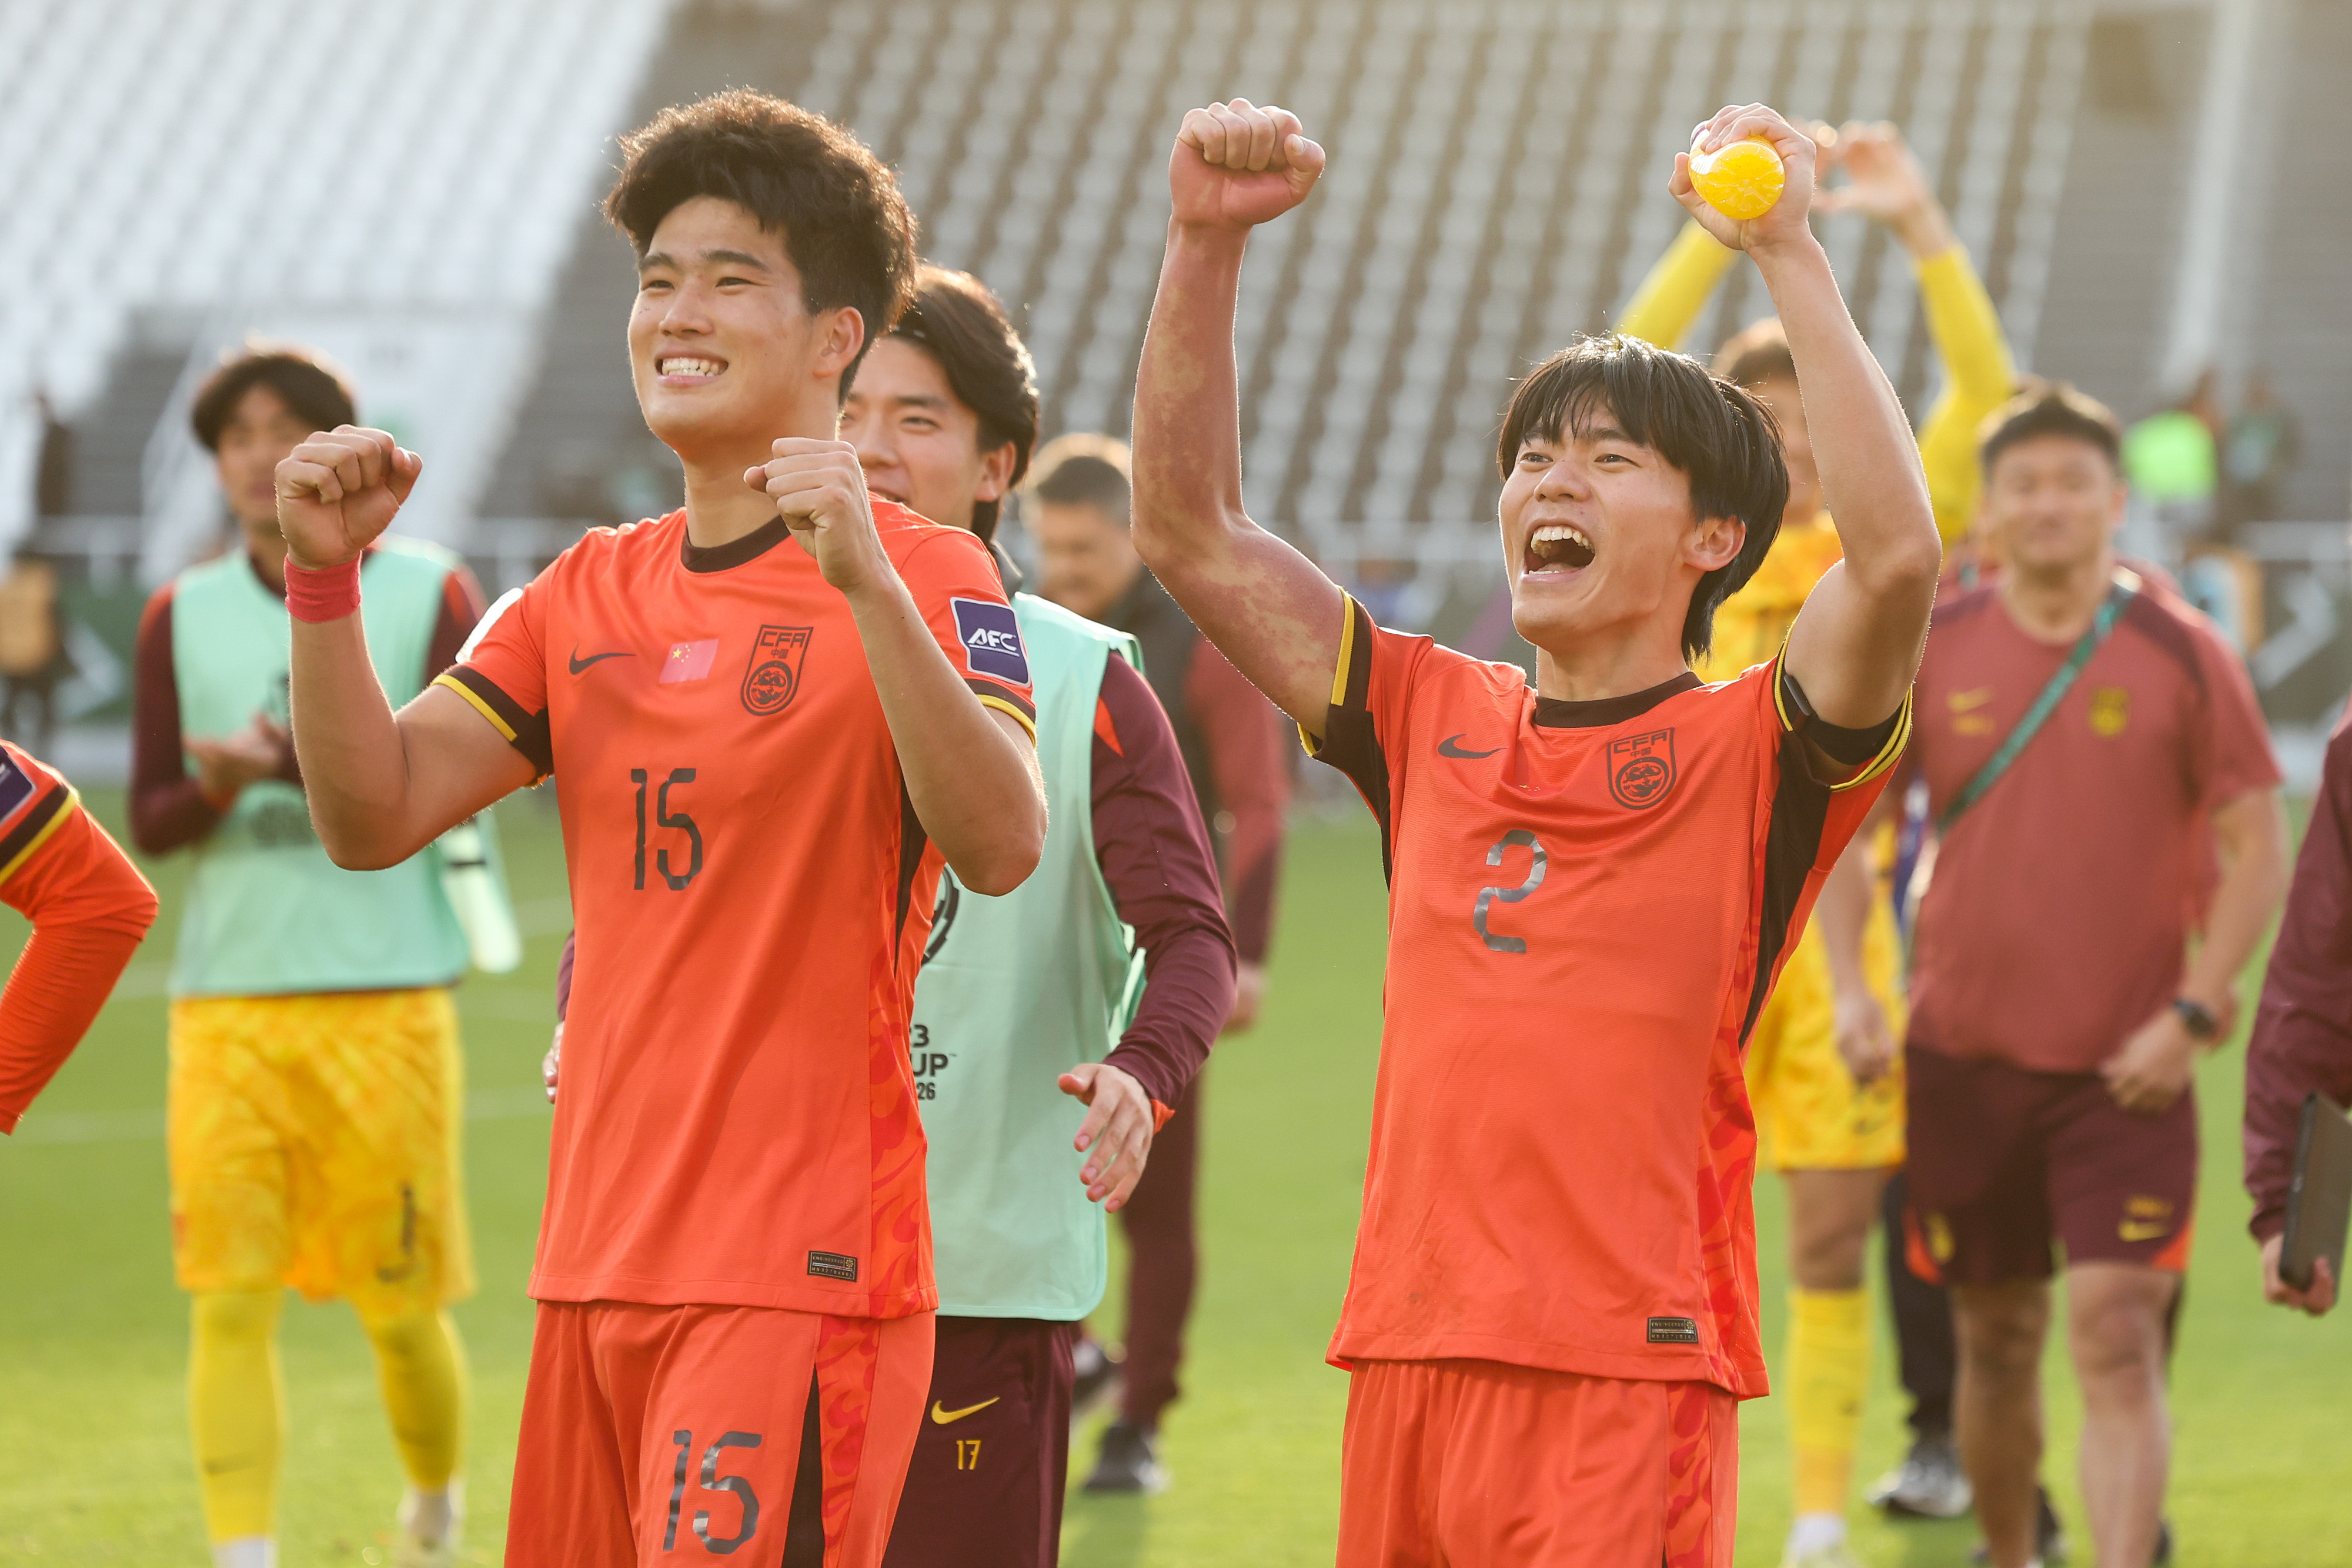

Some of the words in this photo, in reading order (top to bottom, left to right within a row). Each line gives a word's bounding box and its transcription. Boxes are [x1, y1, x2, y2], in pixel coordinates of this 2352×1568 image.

[760, 631, 806, 648] CFA
[967, 628, 1017, 651] AFC
[1614, 732, 1667, 754] CFA
[631, 768, 703, 891] 15
[1473, 829, 1547, 954] 2
[910, 1024, 930, 1047] 3
[910, 1053, 948, 1077] UP
[916, 1082, 936, 1101] 26
[956, 1440, 981, 1470] 17
[663, 1430, 763, 1555] 15
